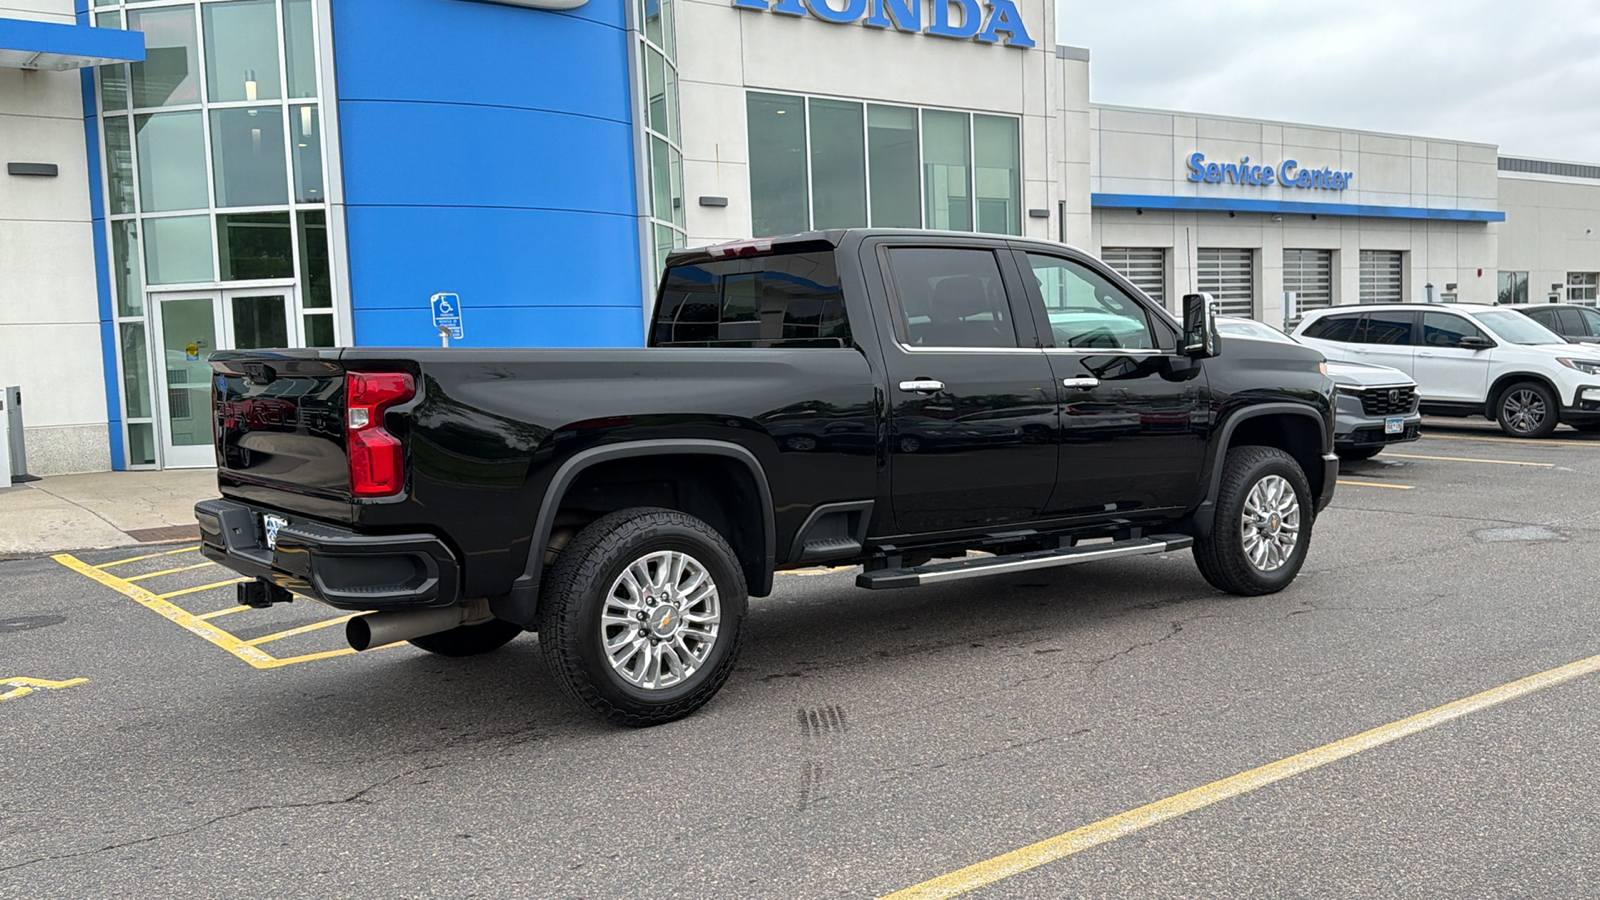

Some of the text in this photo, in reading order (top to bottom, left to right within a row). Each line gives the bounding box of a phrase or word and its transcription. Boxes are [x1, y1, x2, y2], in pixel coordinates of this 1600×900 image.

[733, 0, 1035, 47] NDA
[1188, 152, 1353, 190] Service Center
